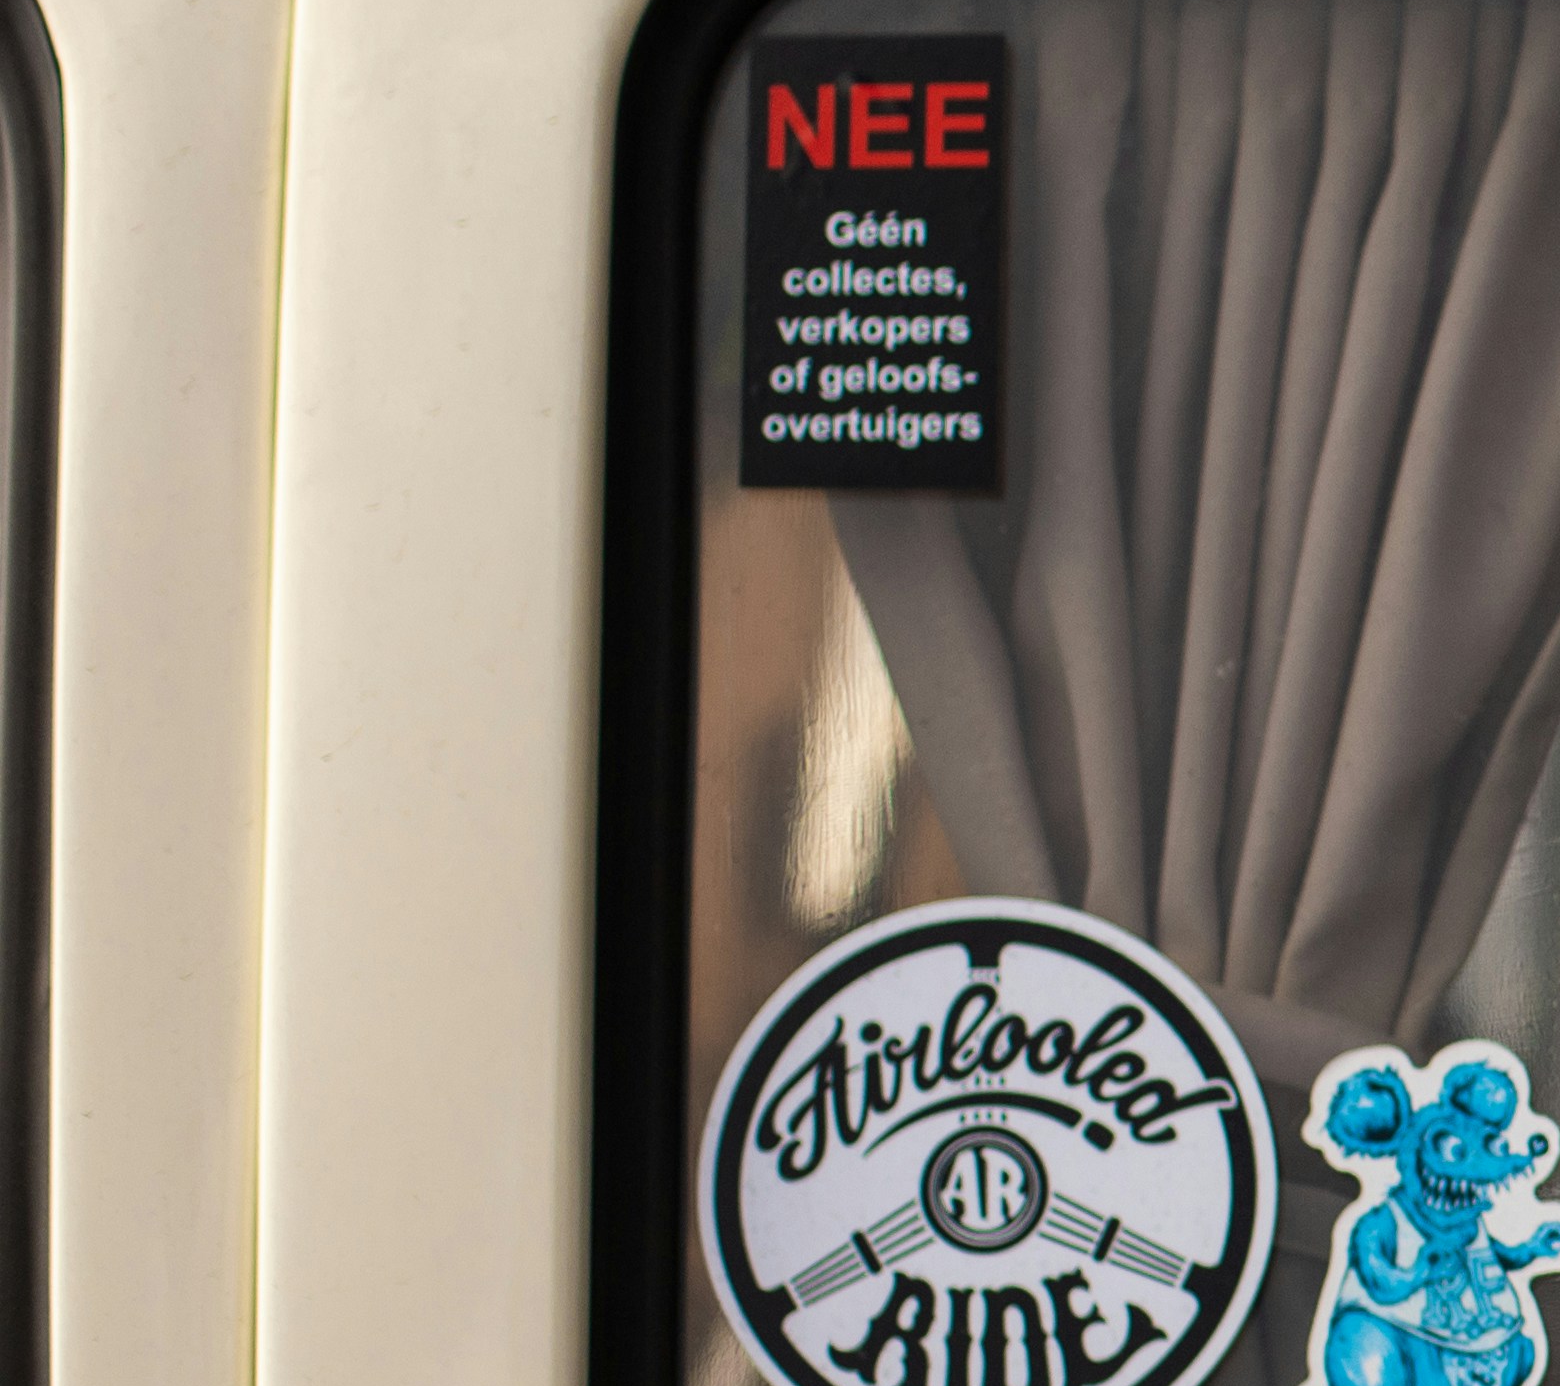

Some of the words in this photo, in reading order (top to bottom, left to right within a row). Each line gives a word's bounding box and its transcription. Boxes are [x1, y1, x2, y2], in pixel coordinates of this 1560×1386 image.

[767, 82, 990, 170] NEE
[825, 211, 926, 247] Géén
[783, 260, 966, 300] collectes,
[777, 309, 970, 351] verkopers
[769, 357, 812, 393] of
[818, 356, 978, 400] geloofs-
[762, 406, 982, 448] overtuigers
